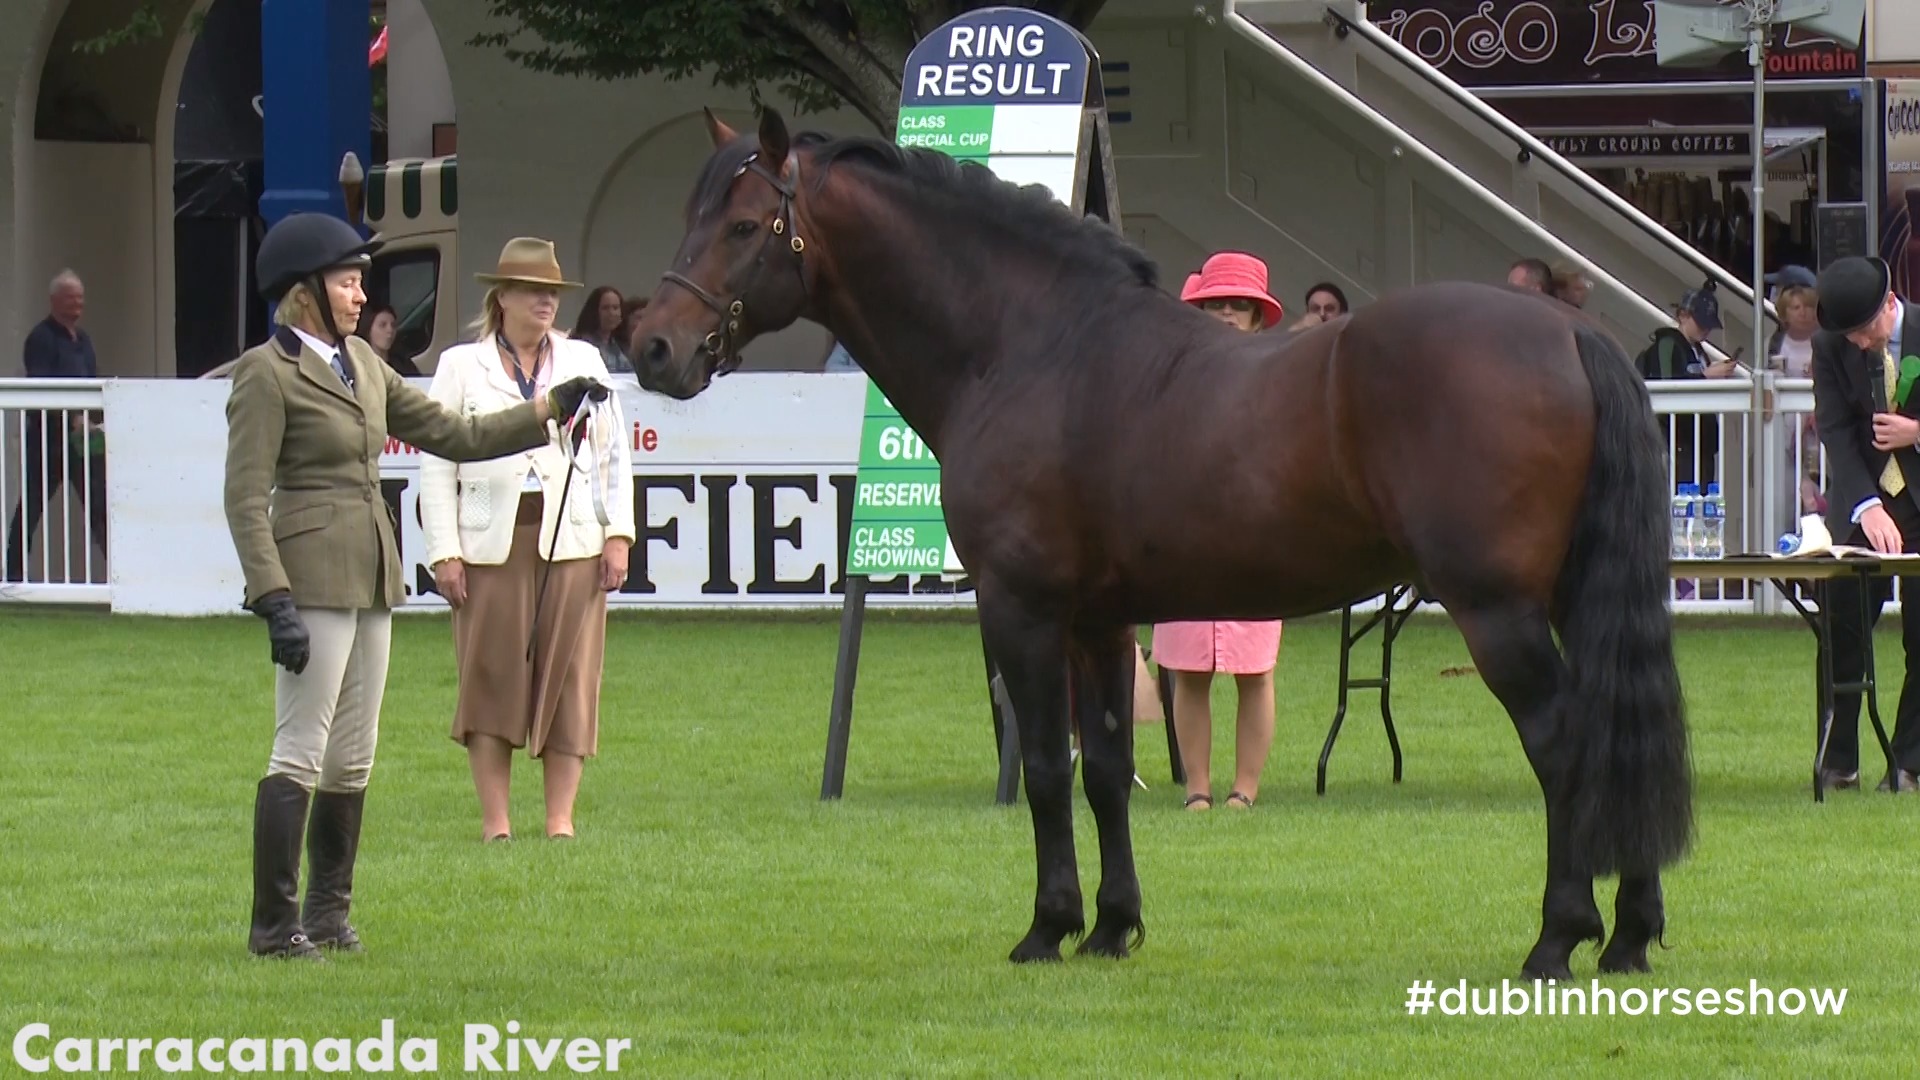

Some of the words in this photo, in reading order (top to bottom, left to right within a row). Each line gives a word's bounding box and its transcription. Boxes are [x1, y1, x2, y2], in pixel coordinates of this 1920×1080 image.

[948, 24, 1044, 58] RING
[917, 63, 1070, 97] RESULT
[901, 115, 946, 129] CLASS
[899, 133, 956, 147] SPECIAL
[959, 132, 989, 147] CUP
[1671, 135, 1735, 152] COFFEE
[619, 474, 977, 594] FIEL
[855, 527, 915, 547] CLASS
[853, 547, 940, 568] SHOWING
